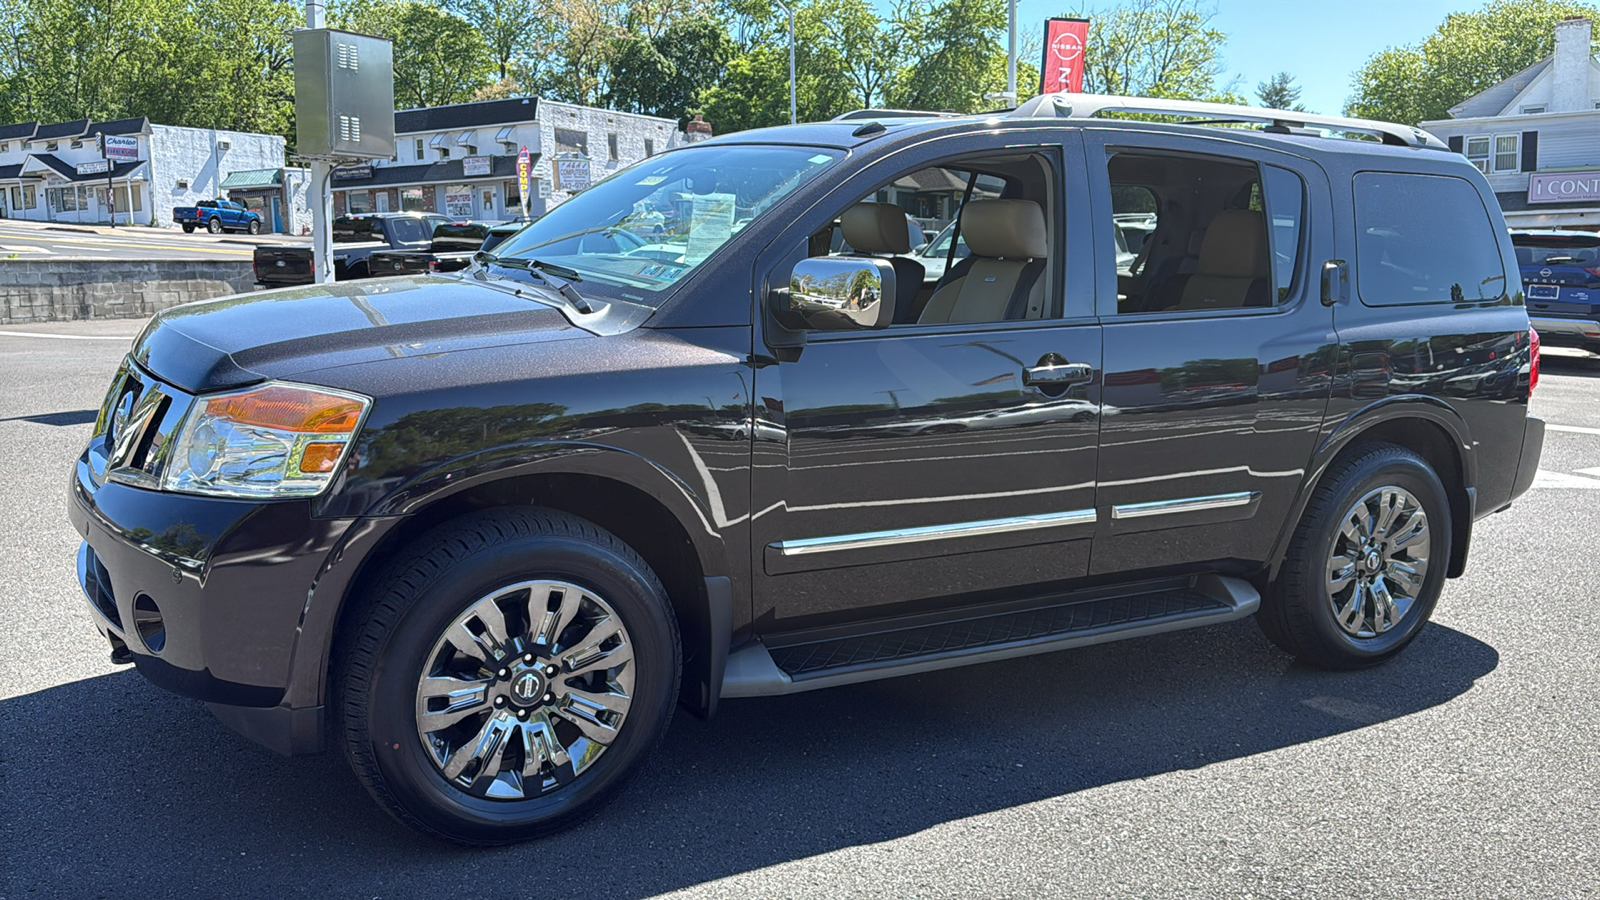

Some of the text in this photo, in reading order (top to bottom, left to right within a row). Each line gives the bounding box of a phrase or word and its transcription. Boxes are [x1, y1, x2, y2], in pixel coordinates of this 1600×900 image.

[1051, 43, 1083, 51] NISSAN
[1547, 179, 1600, 195] CONT
[446, 194, 471, 203] COMPUTERS
